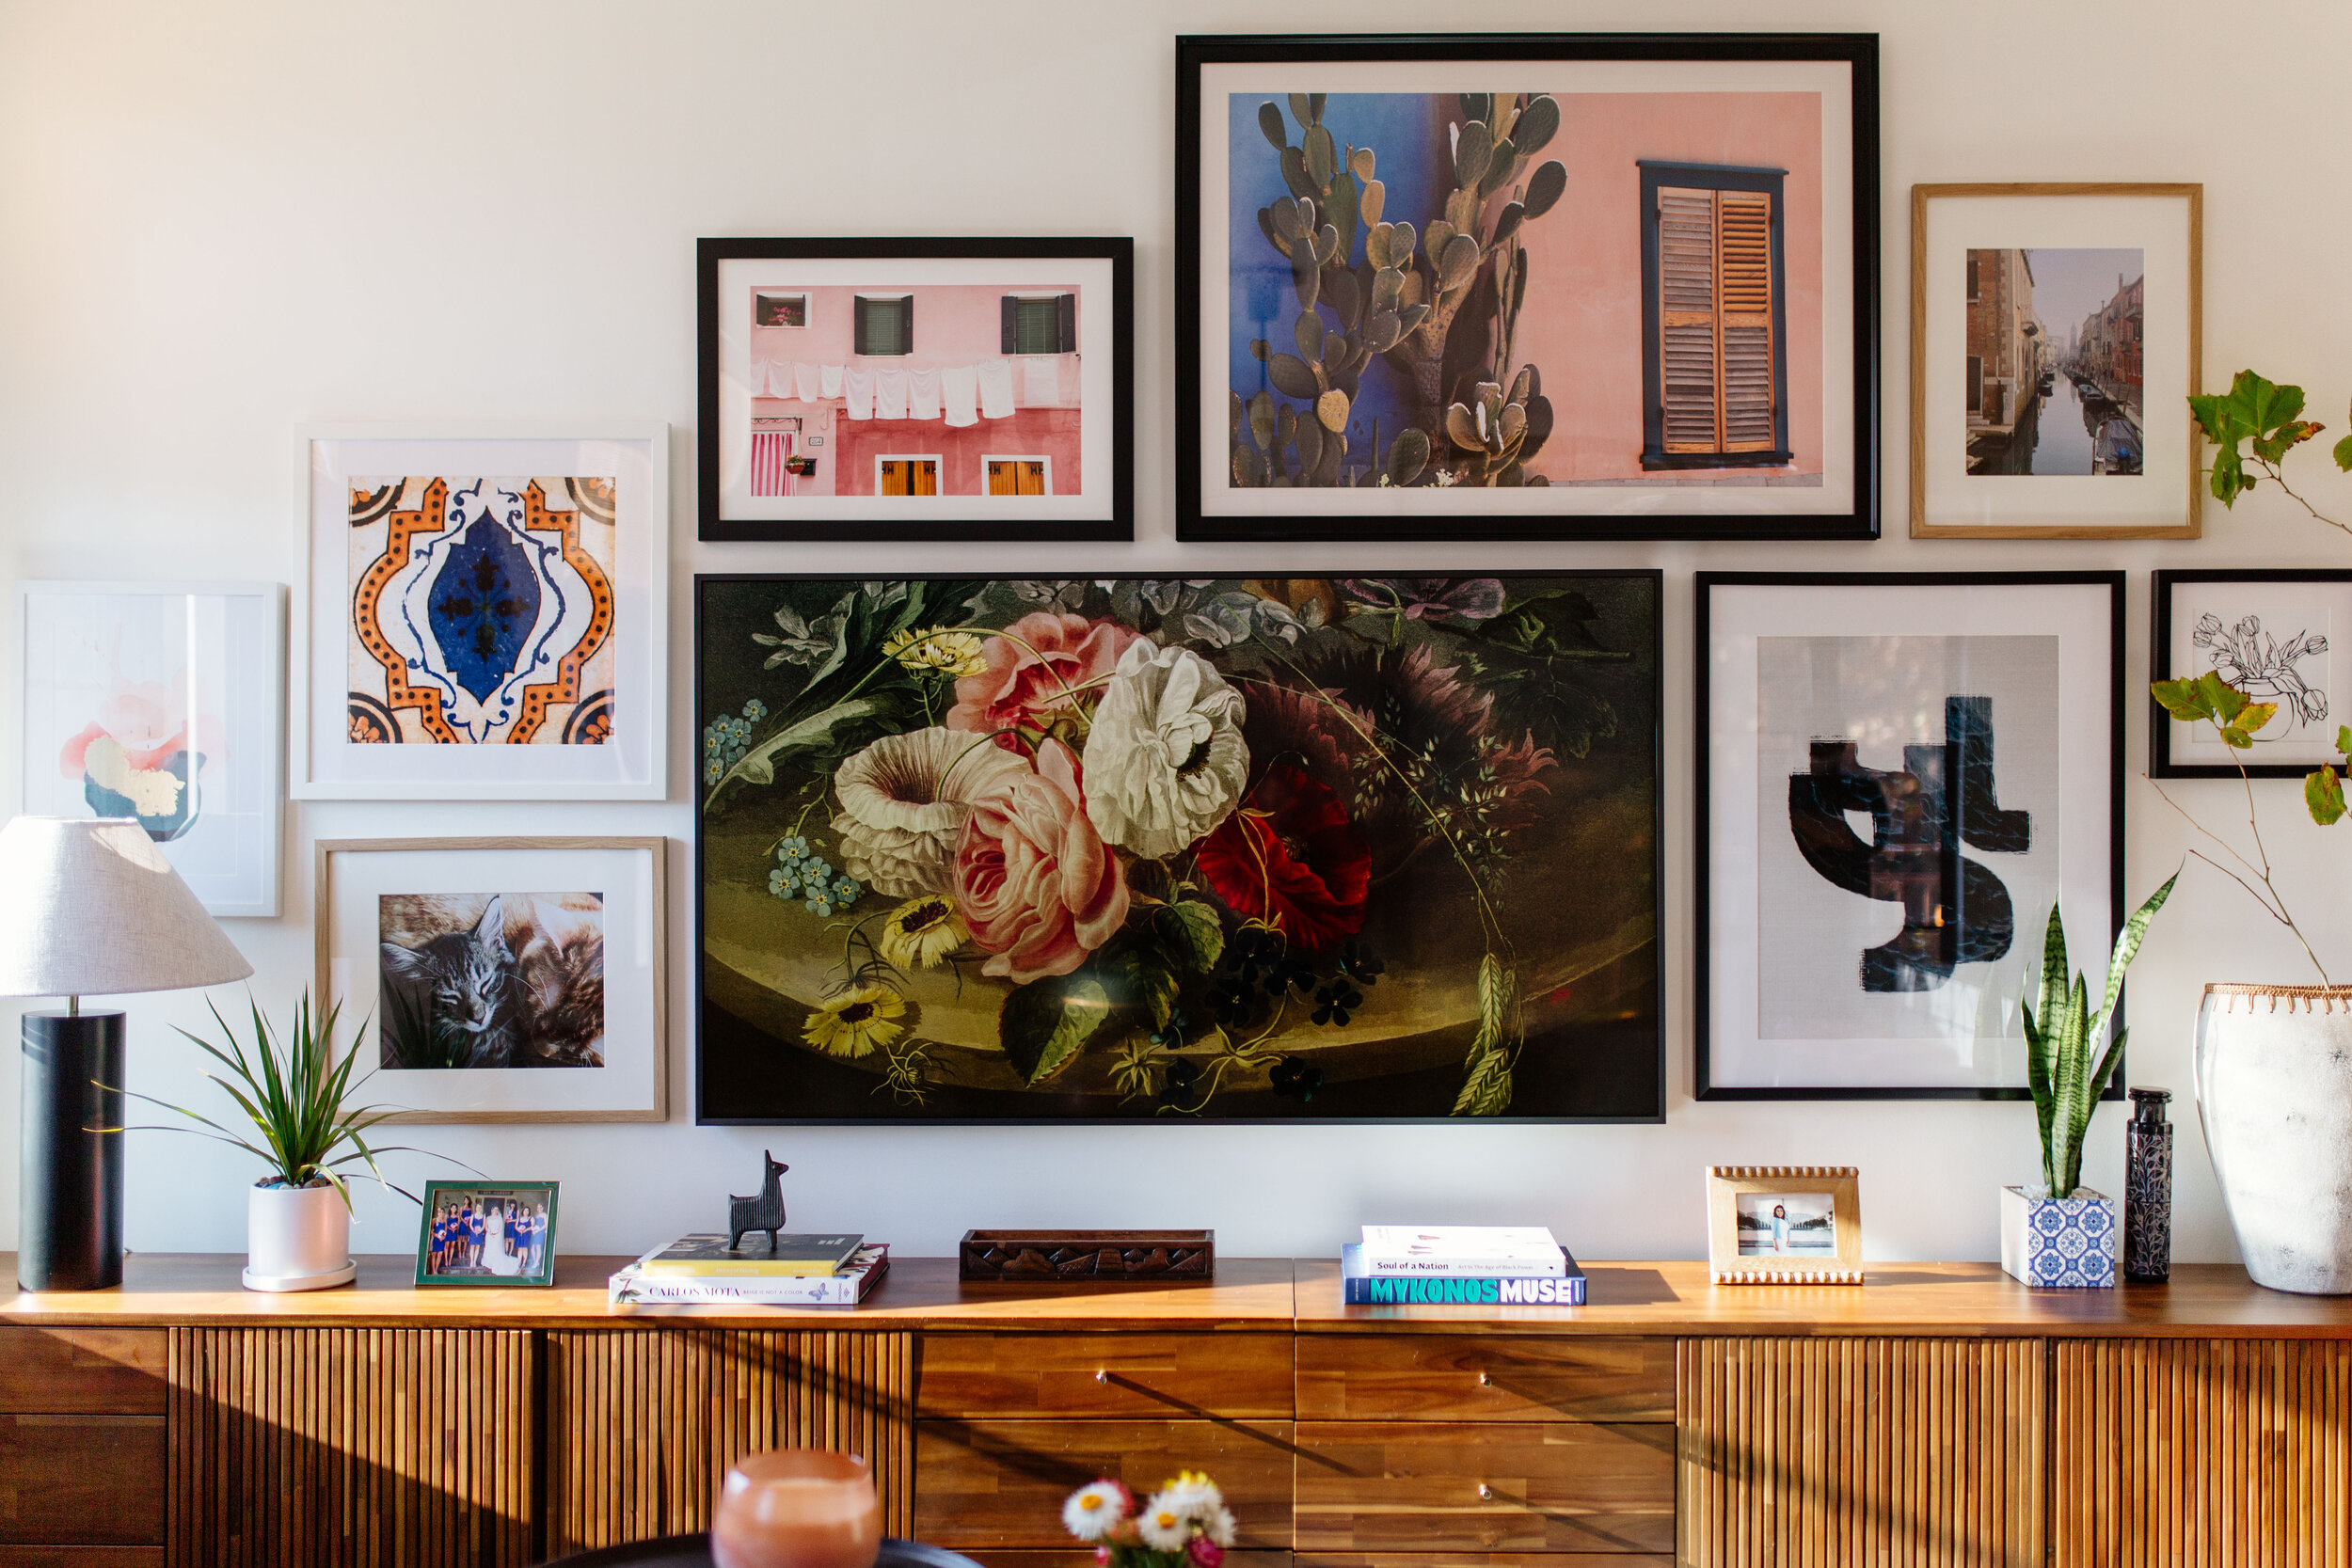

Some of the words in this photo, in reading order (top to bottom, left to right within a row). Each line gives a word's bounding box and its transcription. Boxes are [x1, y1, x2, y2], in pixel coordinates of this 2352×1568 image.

[1377, 1261, 1398, 1271] Soul
[1399, 1261, 1409, 1271] of
[1418, 1262, 1450, 1271] Nation
[649, 1287, 700, 1297] CARLOS
[704, 1287, 741, 1297] MOTA
[1370, 1278, 1499, 1303] MYKONOS
[1500, 1279, 1572, 1303] MUSE
